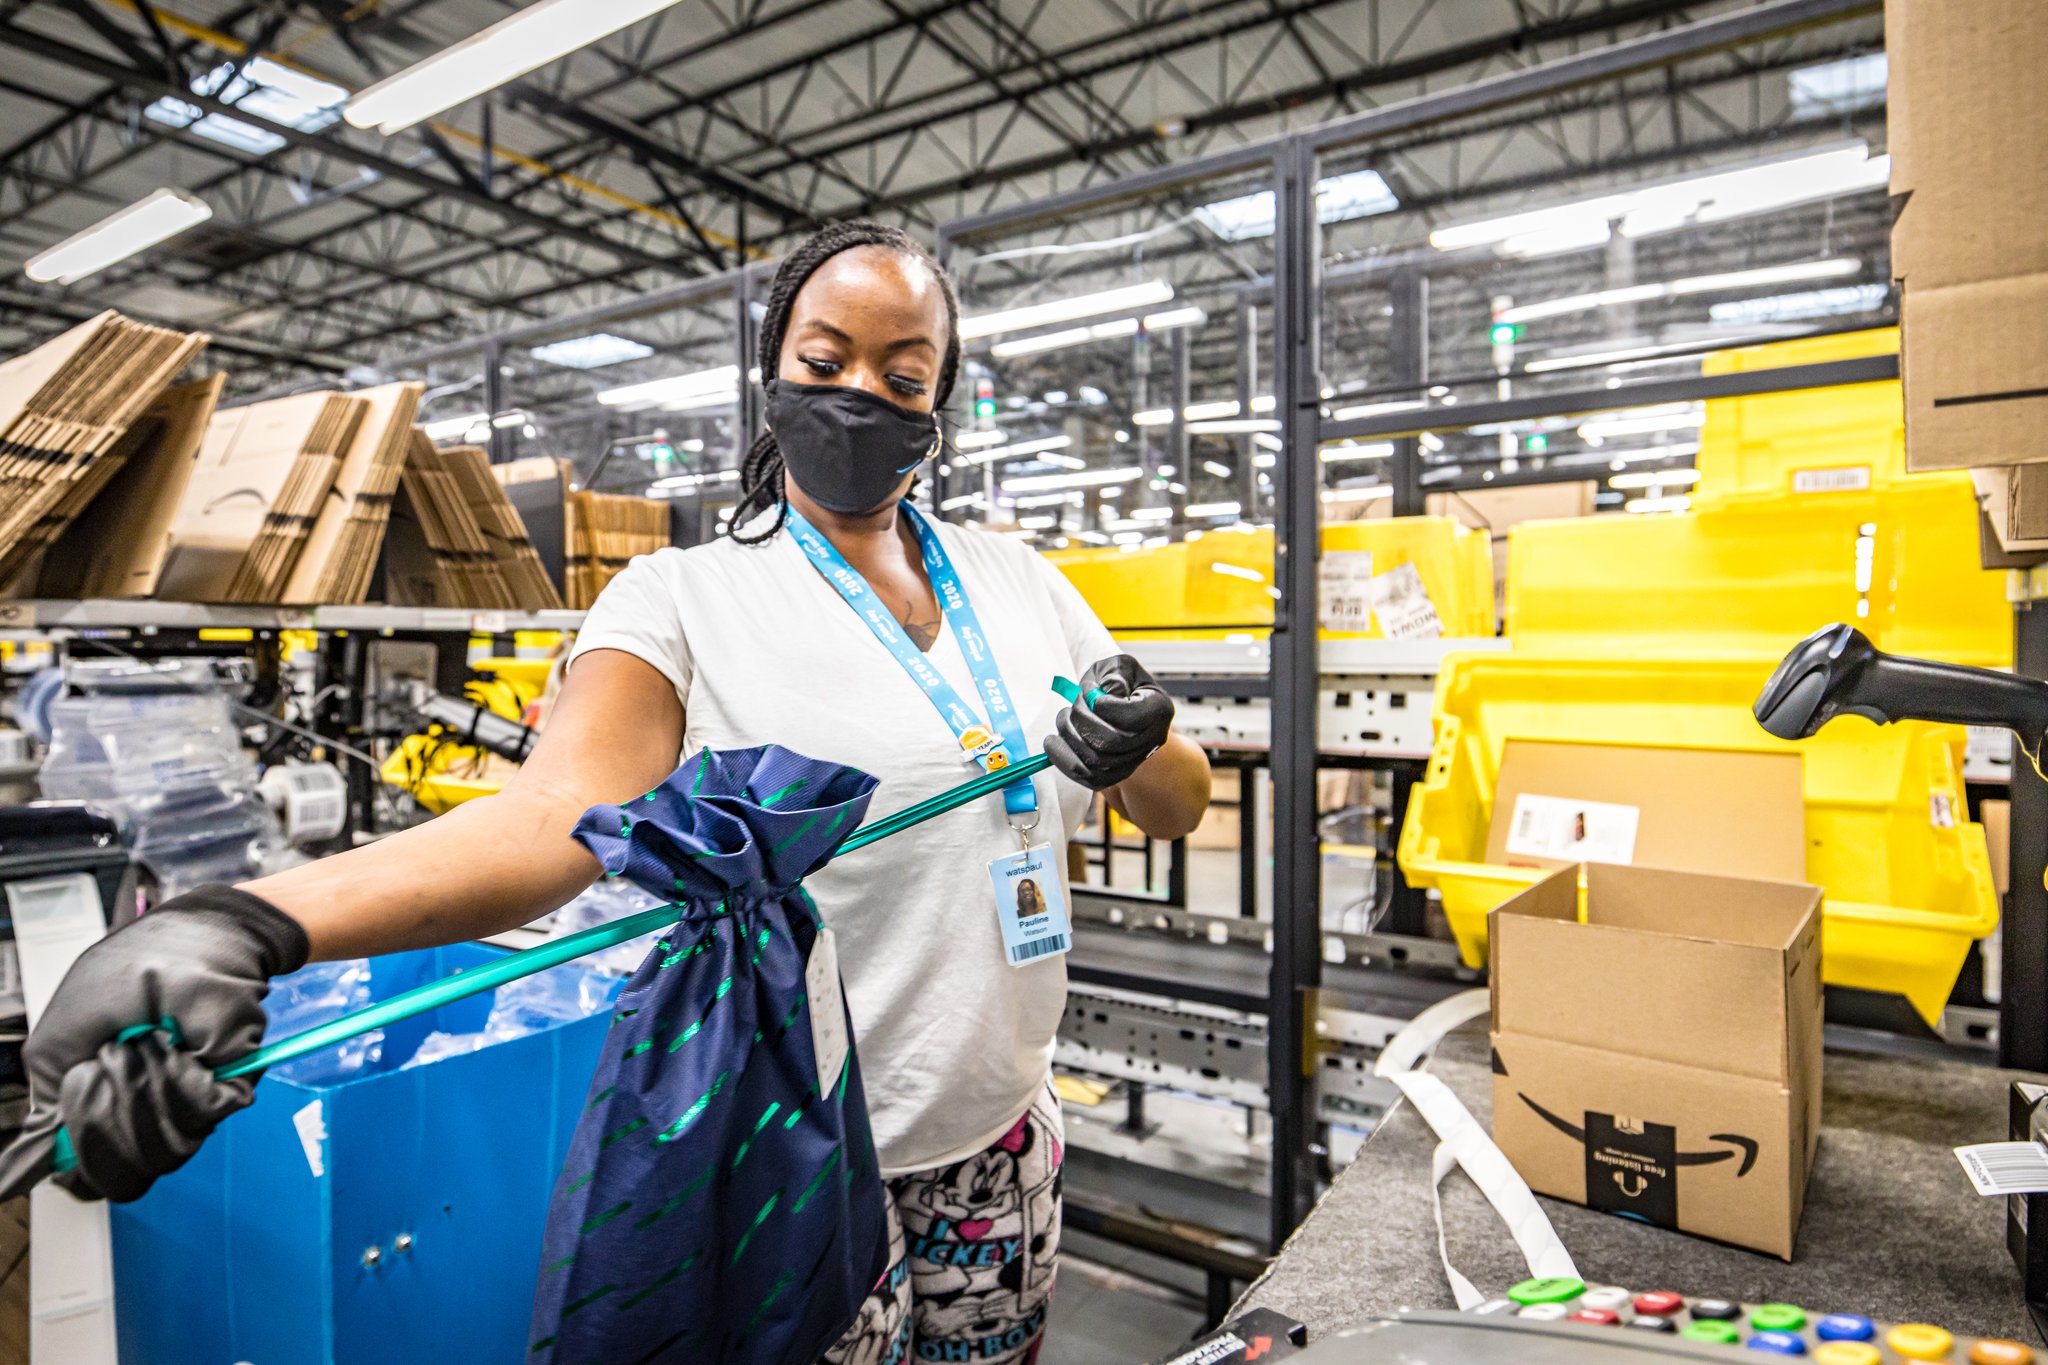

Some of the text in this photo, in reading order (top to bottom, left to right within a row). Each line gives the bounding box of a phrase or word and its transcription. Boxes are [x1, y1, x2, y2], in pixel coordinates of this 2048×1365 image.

[834, 569, 864, 597] 2020
[941, 580, 963, 610] 2020
[907, 657, 940, 687] 2020
[984, 678, 1008, 714] 2020
[1005, 861, 1043, 877] watspaul
[1019, 916, 1049, 928] Pauline
[1593, 1150, 1666, 1178] free listening
[910, 1238, 1022, 1268] ICKEY
[919, 1339, 970, 1362] OH
[982, 1310, 1042, 1357] BOY
